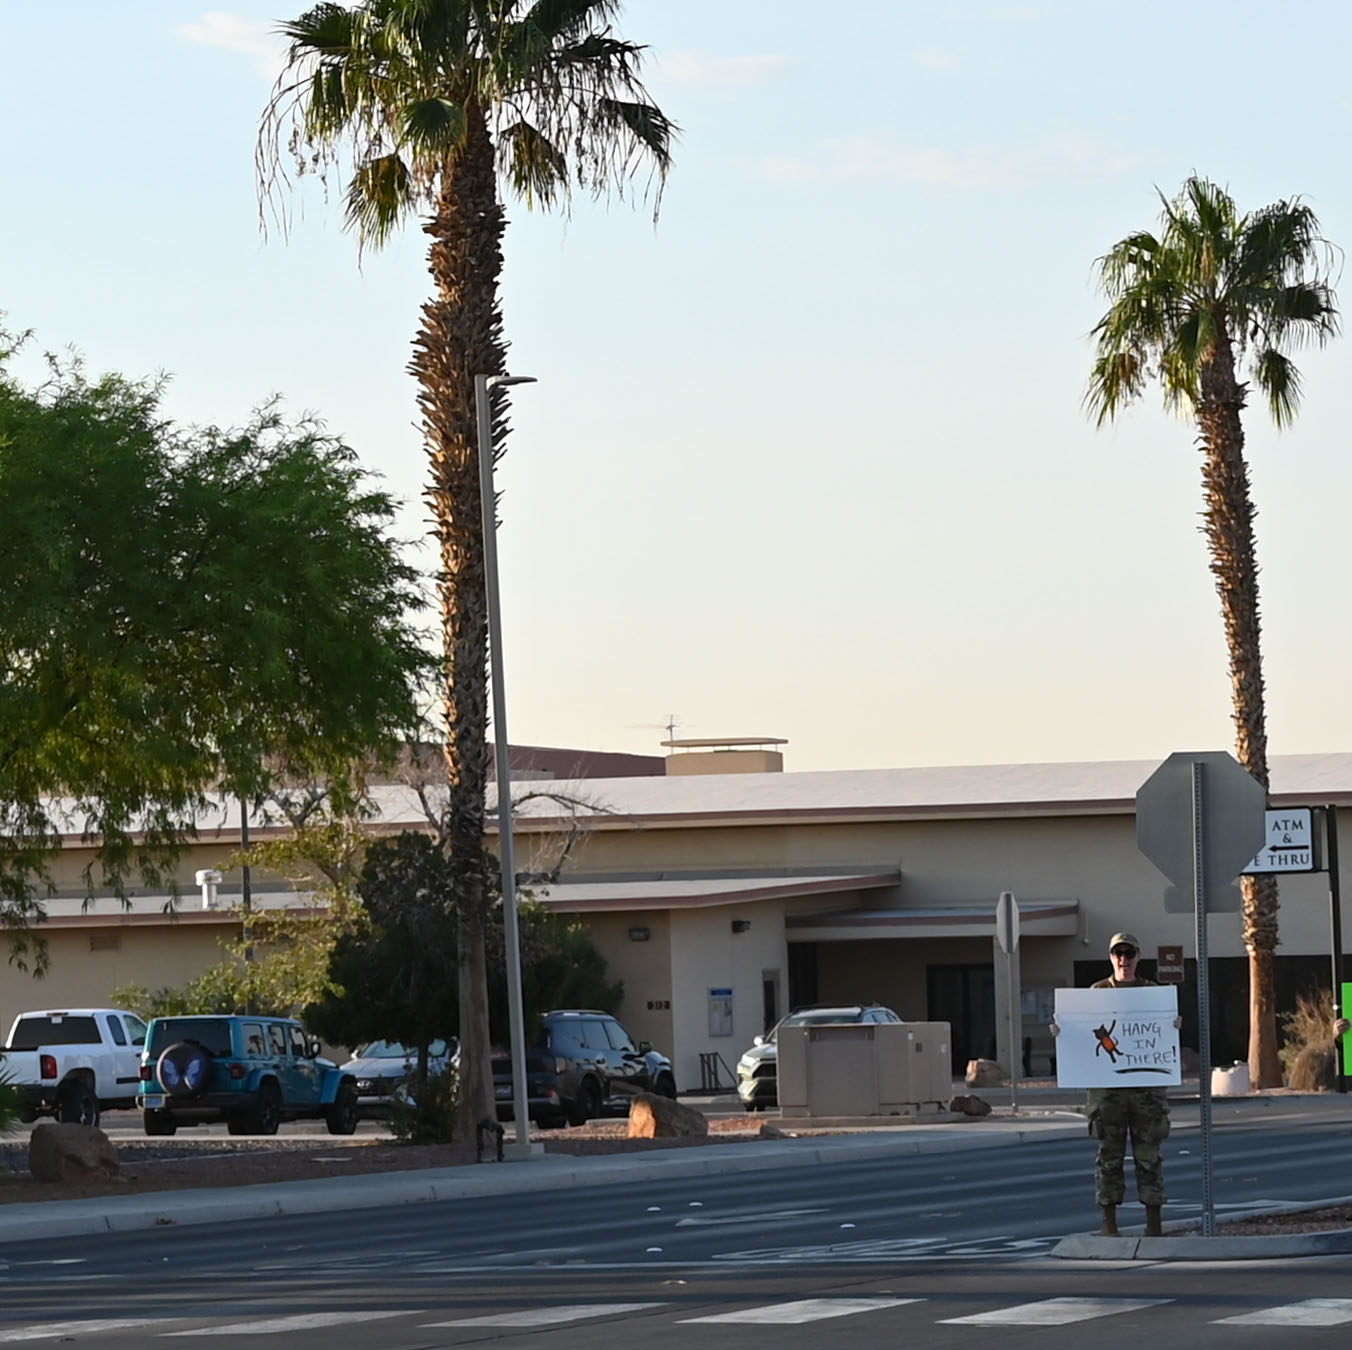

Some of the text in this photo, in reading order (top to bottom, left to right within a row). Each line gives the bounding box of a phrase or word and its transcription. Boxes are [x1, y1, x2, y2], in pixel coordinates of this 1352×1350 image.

[1272, 819, 1304, 832] ATM
[1282, 833, 1293, 844] &
[1267, 853, 1310, 866] THRU
[1122, 1022, 1162, 1038] HANG
[1133, 1038, 1156, 1049] IN
[1124, 1045, 1177, 1065] THERE!
